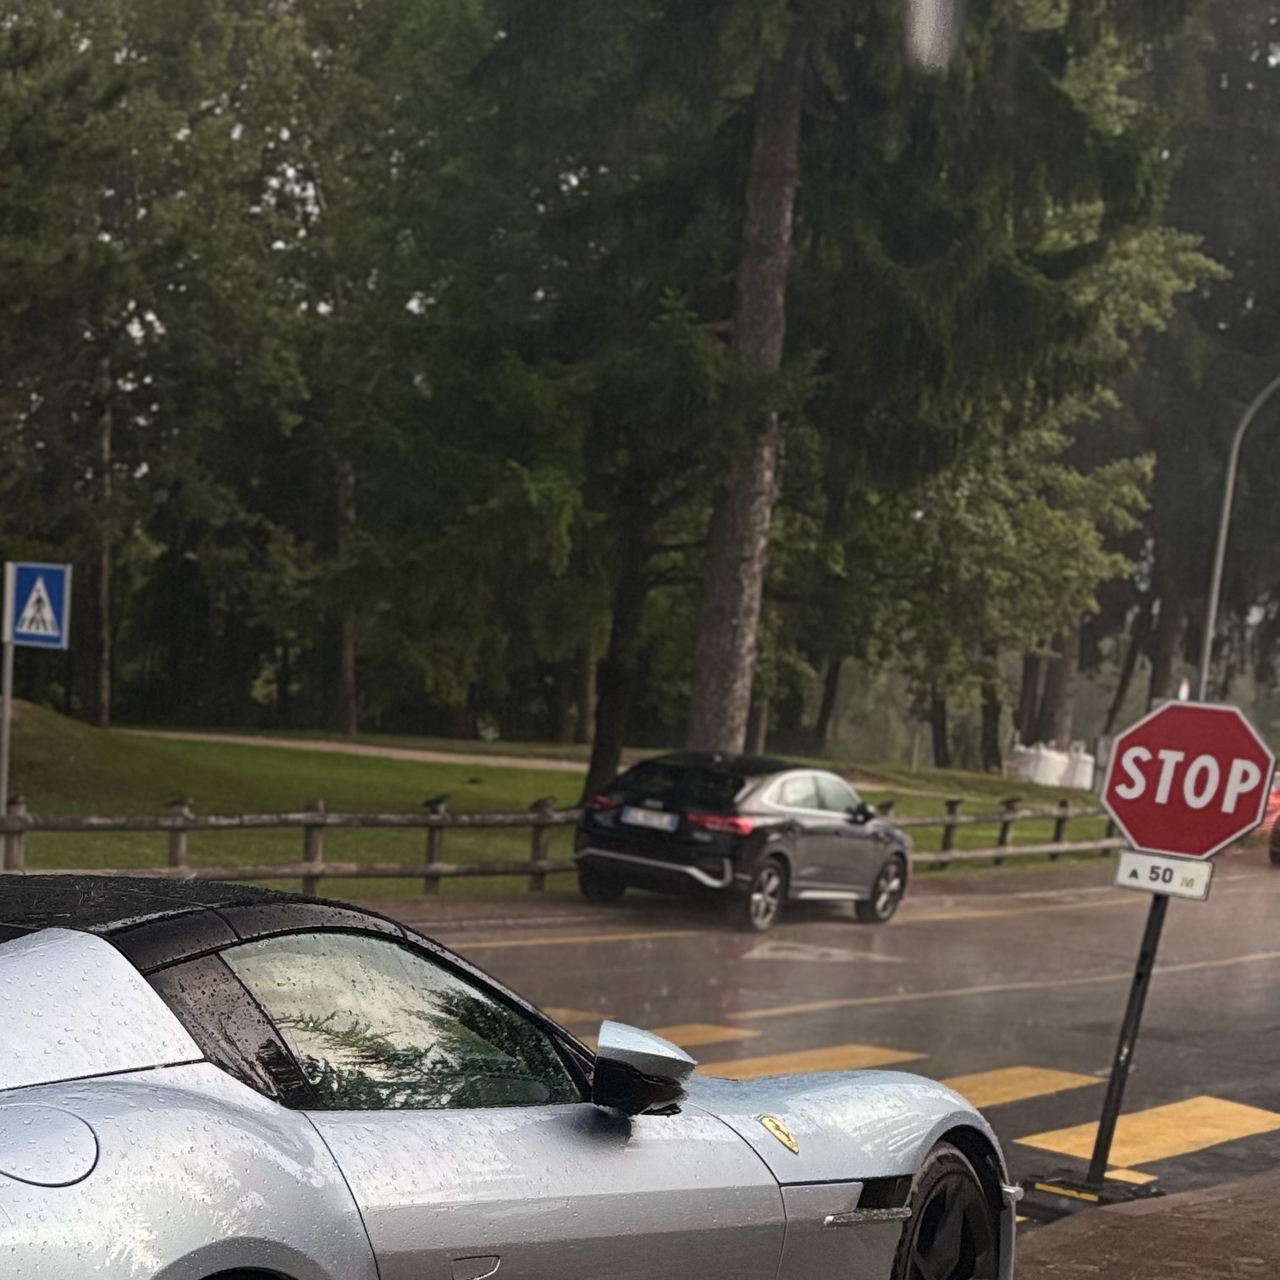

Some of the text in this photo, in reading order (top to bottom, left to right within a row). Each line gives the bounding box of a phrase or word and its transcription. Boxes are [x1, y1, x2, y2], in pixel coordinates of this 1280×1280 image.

[1115, 746, 1261, 814] STOP
[1128, 868, 1139, 880] A
[1149, 865, 1174, 884] 50
